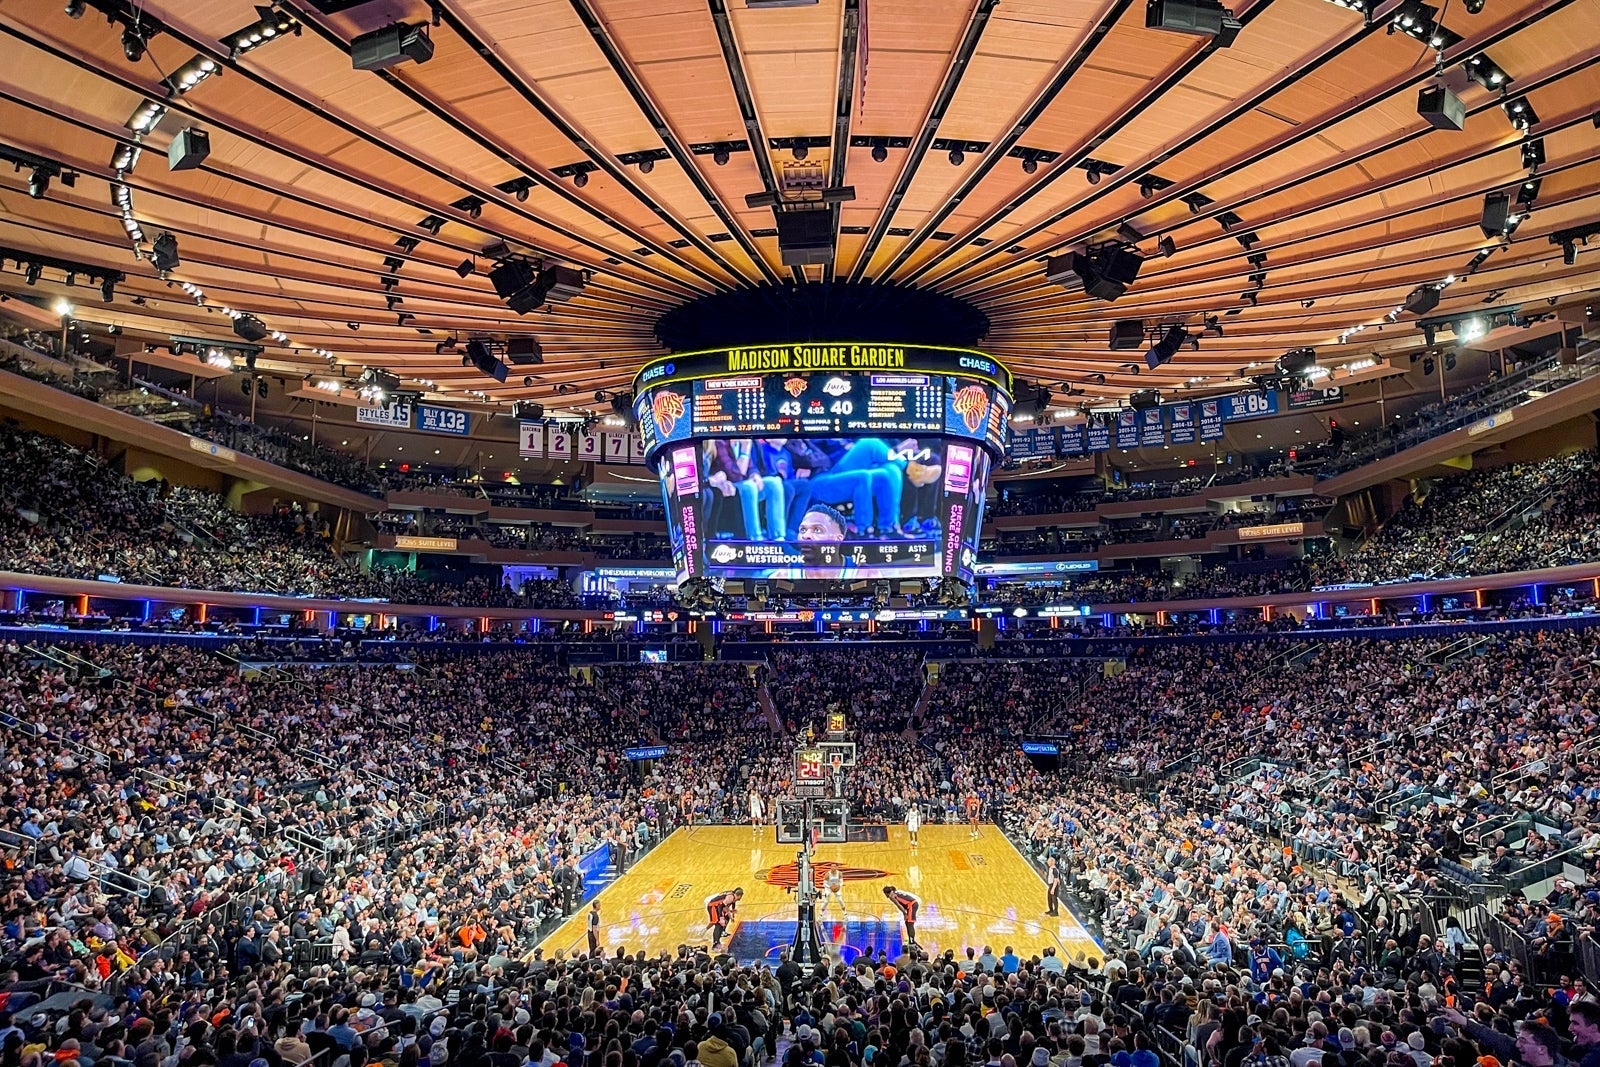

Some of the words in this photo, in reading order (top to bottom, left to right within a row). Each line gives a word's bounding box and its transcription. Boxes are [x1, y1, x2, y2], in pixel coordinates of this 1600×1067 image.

[728, 348, 789, 371] MADISON
[793, 346, 847, 368] SQUARE
[851, 345, 904, 367] GARDEN
[959, 357, 990, 371] CHASE
[642, 365, 665, 382] CHASE
[779, 401, 802, 416] 43
[830, 400, 853, 415] 40
[1232, 396, 1246, 406] BILLY
[1248, 395, 1268, 412] 86
[360, 408, 390, 419] STYLES
[392, 404, 408, 422] 15
[424, 408, 438, 418] BILLY
[807, 406, 825, 414] 4:02
[424, 417, 438, 426] JOEL
[440, 411, 466, 430] 132
[528, 433, 534, 449] 1
[555, 436, 564, 451] 2
[585, 438, 594, 453] 3
[612, 440, 621, 454] 7
[687, 506, 696, 536] PIECE
[949, 505, 957, 531] CAKE
[690, 536, 697, 549] OF
[954, 534, 960, 549] OF
[685, 535, 694, 574] MOVING
[745, 546, 784, 555] RUSSELL
[886, 554, 893, 562] 3
[914, 554, 921, 562] 2
[945, 533, 956, 573] MOVING
[746, 555, 805, 563] WESTBROOK
[825, 555, 832, 563] 9
[852, 553, 866, 564] 1/2
[831, 721, 842, 730] 24
[803, 753, 822, 762] 4:02
[801, 762, 820, 778] 24
